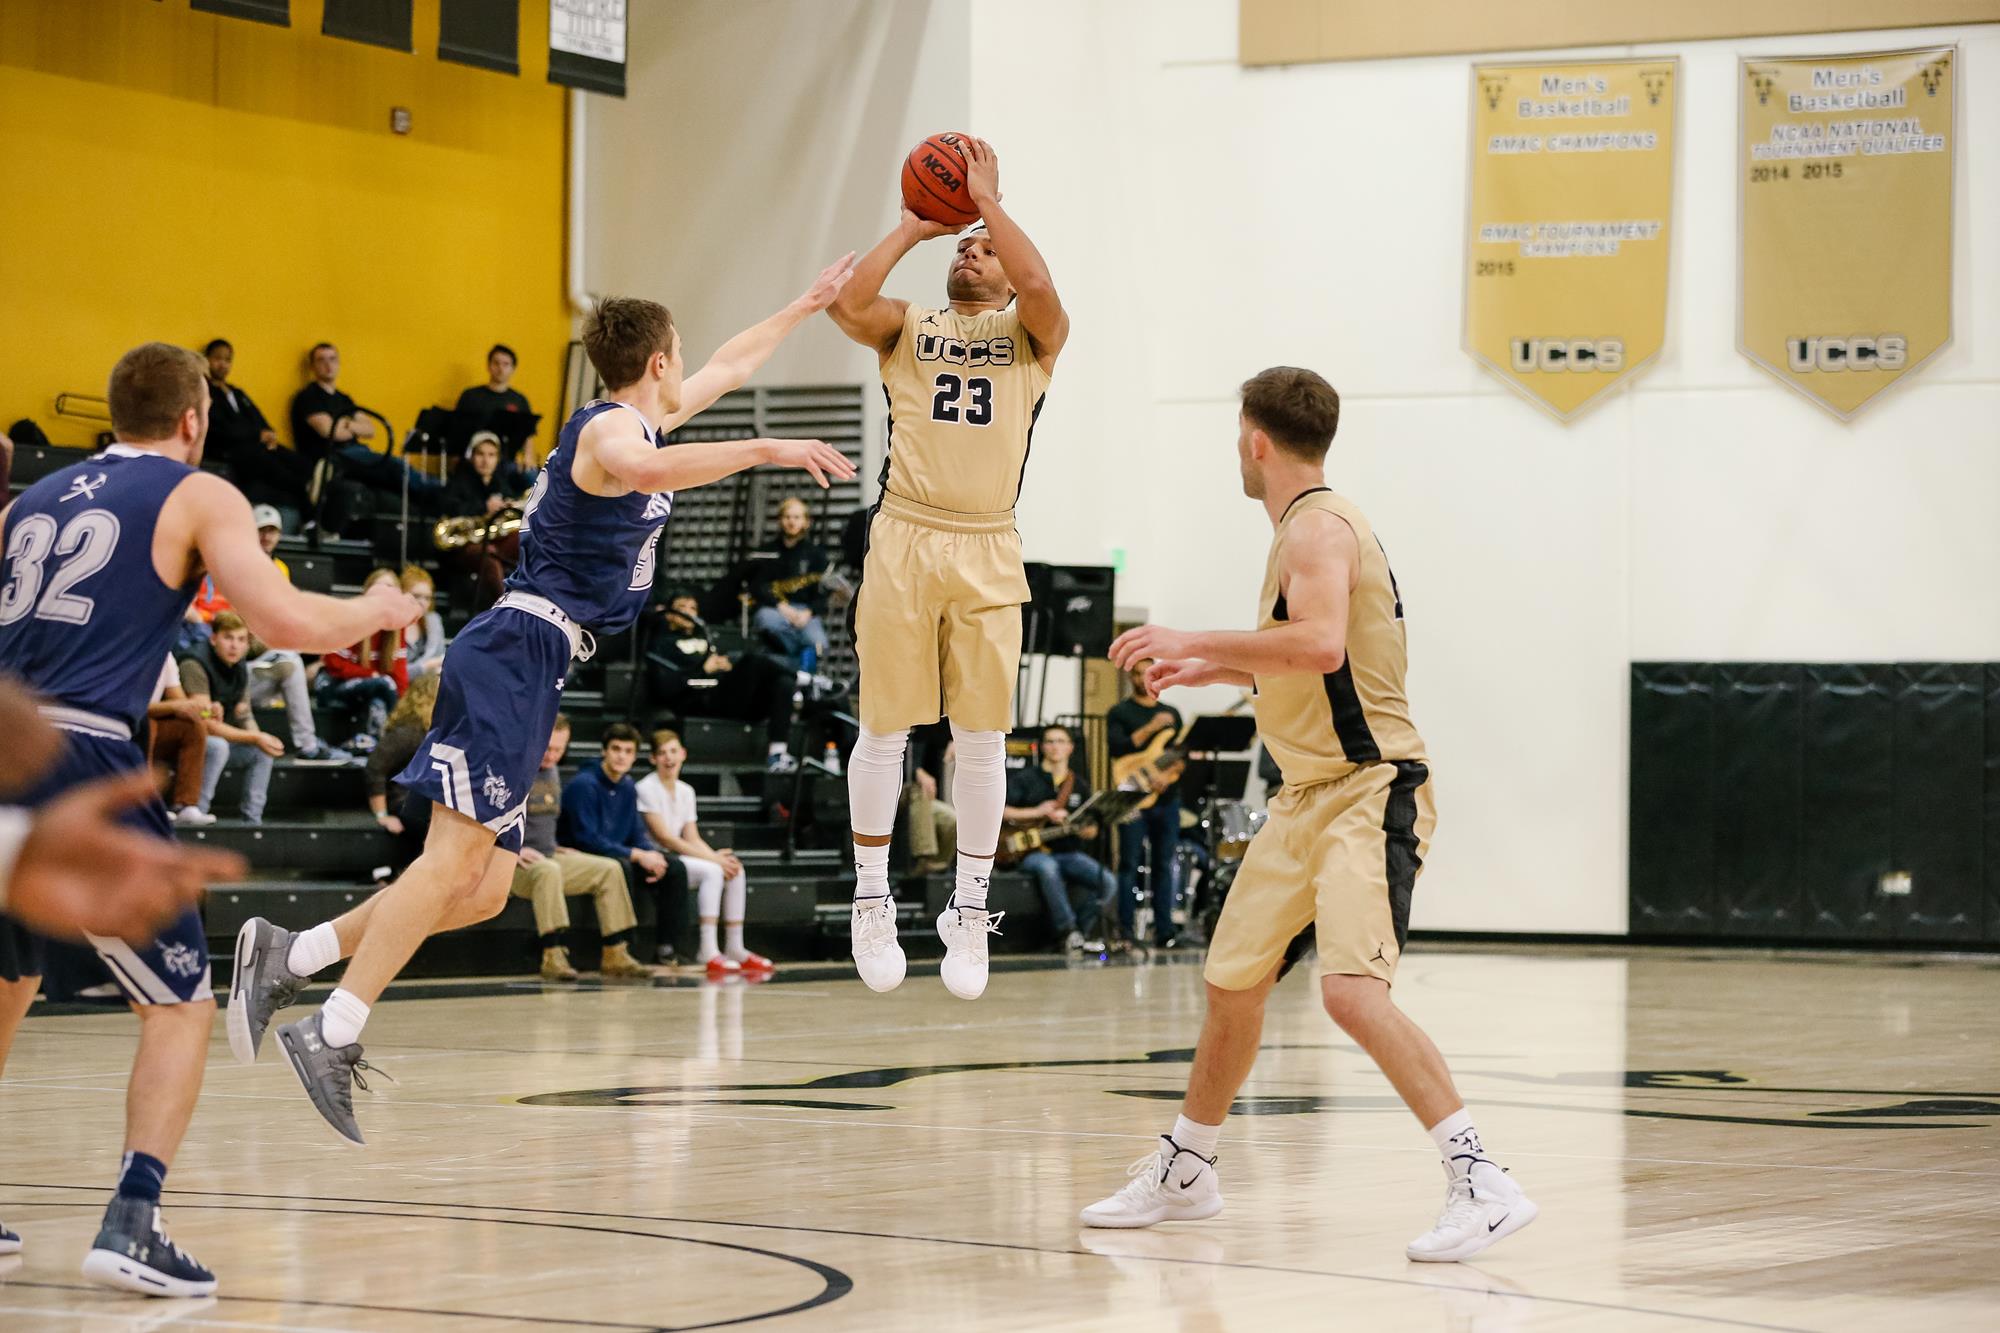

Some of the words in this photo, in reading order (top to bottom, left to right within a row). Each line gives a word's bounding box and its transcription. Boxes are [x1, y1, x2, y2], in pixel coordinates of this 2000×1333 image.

[1541, 75, 1607, 95] Men's
[1813, 66, 1881, 88] Men's
[1517, 97, 1631, 118] Basketball
[1789, 88, 1905, 112] Basketball
[1546, 131, 1657, 151] CHAMPIONS
[1772, 124, 1824, 143] NCAA
[1829, 118, 1922, 139] NATIONAL
[1753, 141, 1859, 159] TOURNAMENT
[1861, 135, 1945, 155] QUALIFIER
[921, 153, 961, 192] NCAA
[1750, 165, 1790, 182] 2014
[1802, 162, 1843, 180] 2015
[1537, 221, 1661, 241] TOURNAMENT
[916, 334, 1014, 367] UCCS
[1511, 336, 1624, 373] UCCS
[1786, 333, 1907, 373] UCCS
[931, 373, 993, 427] 23
[0, 508, 121, 626] 32
